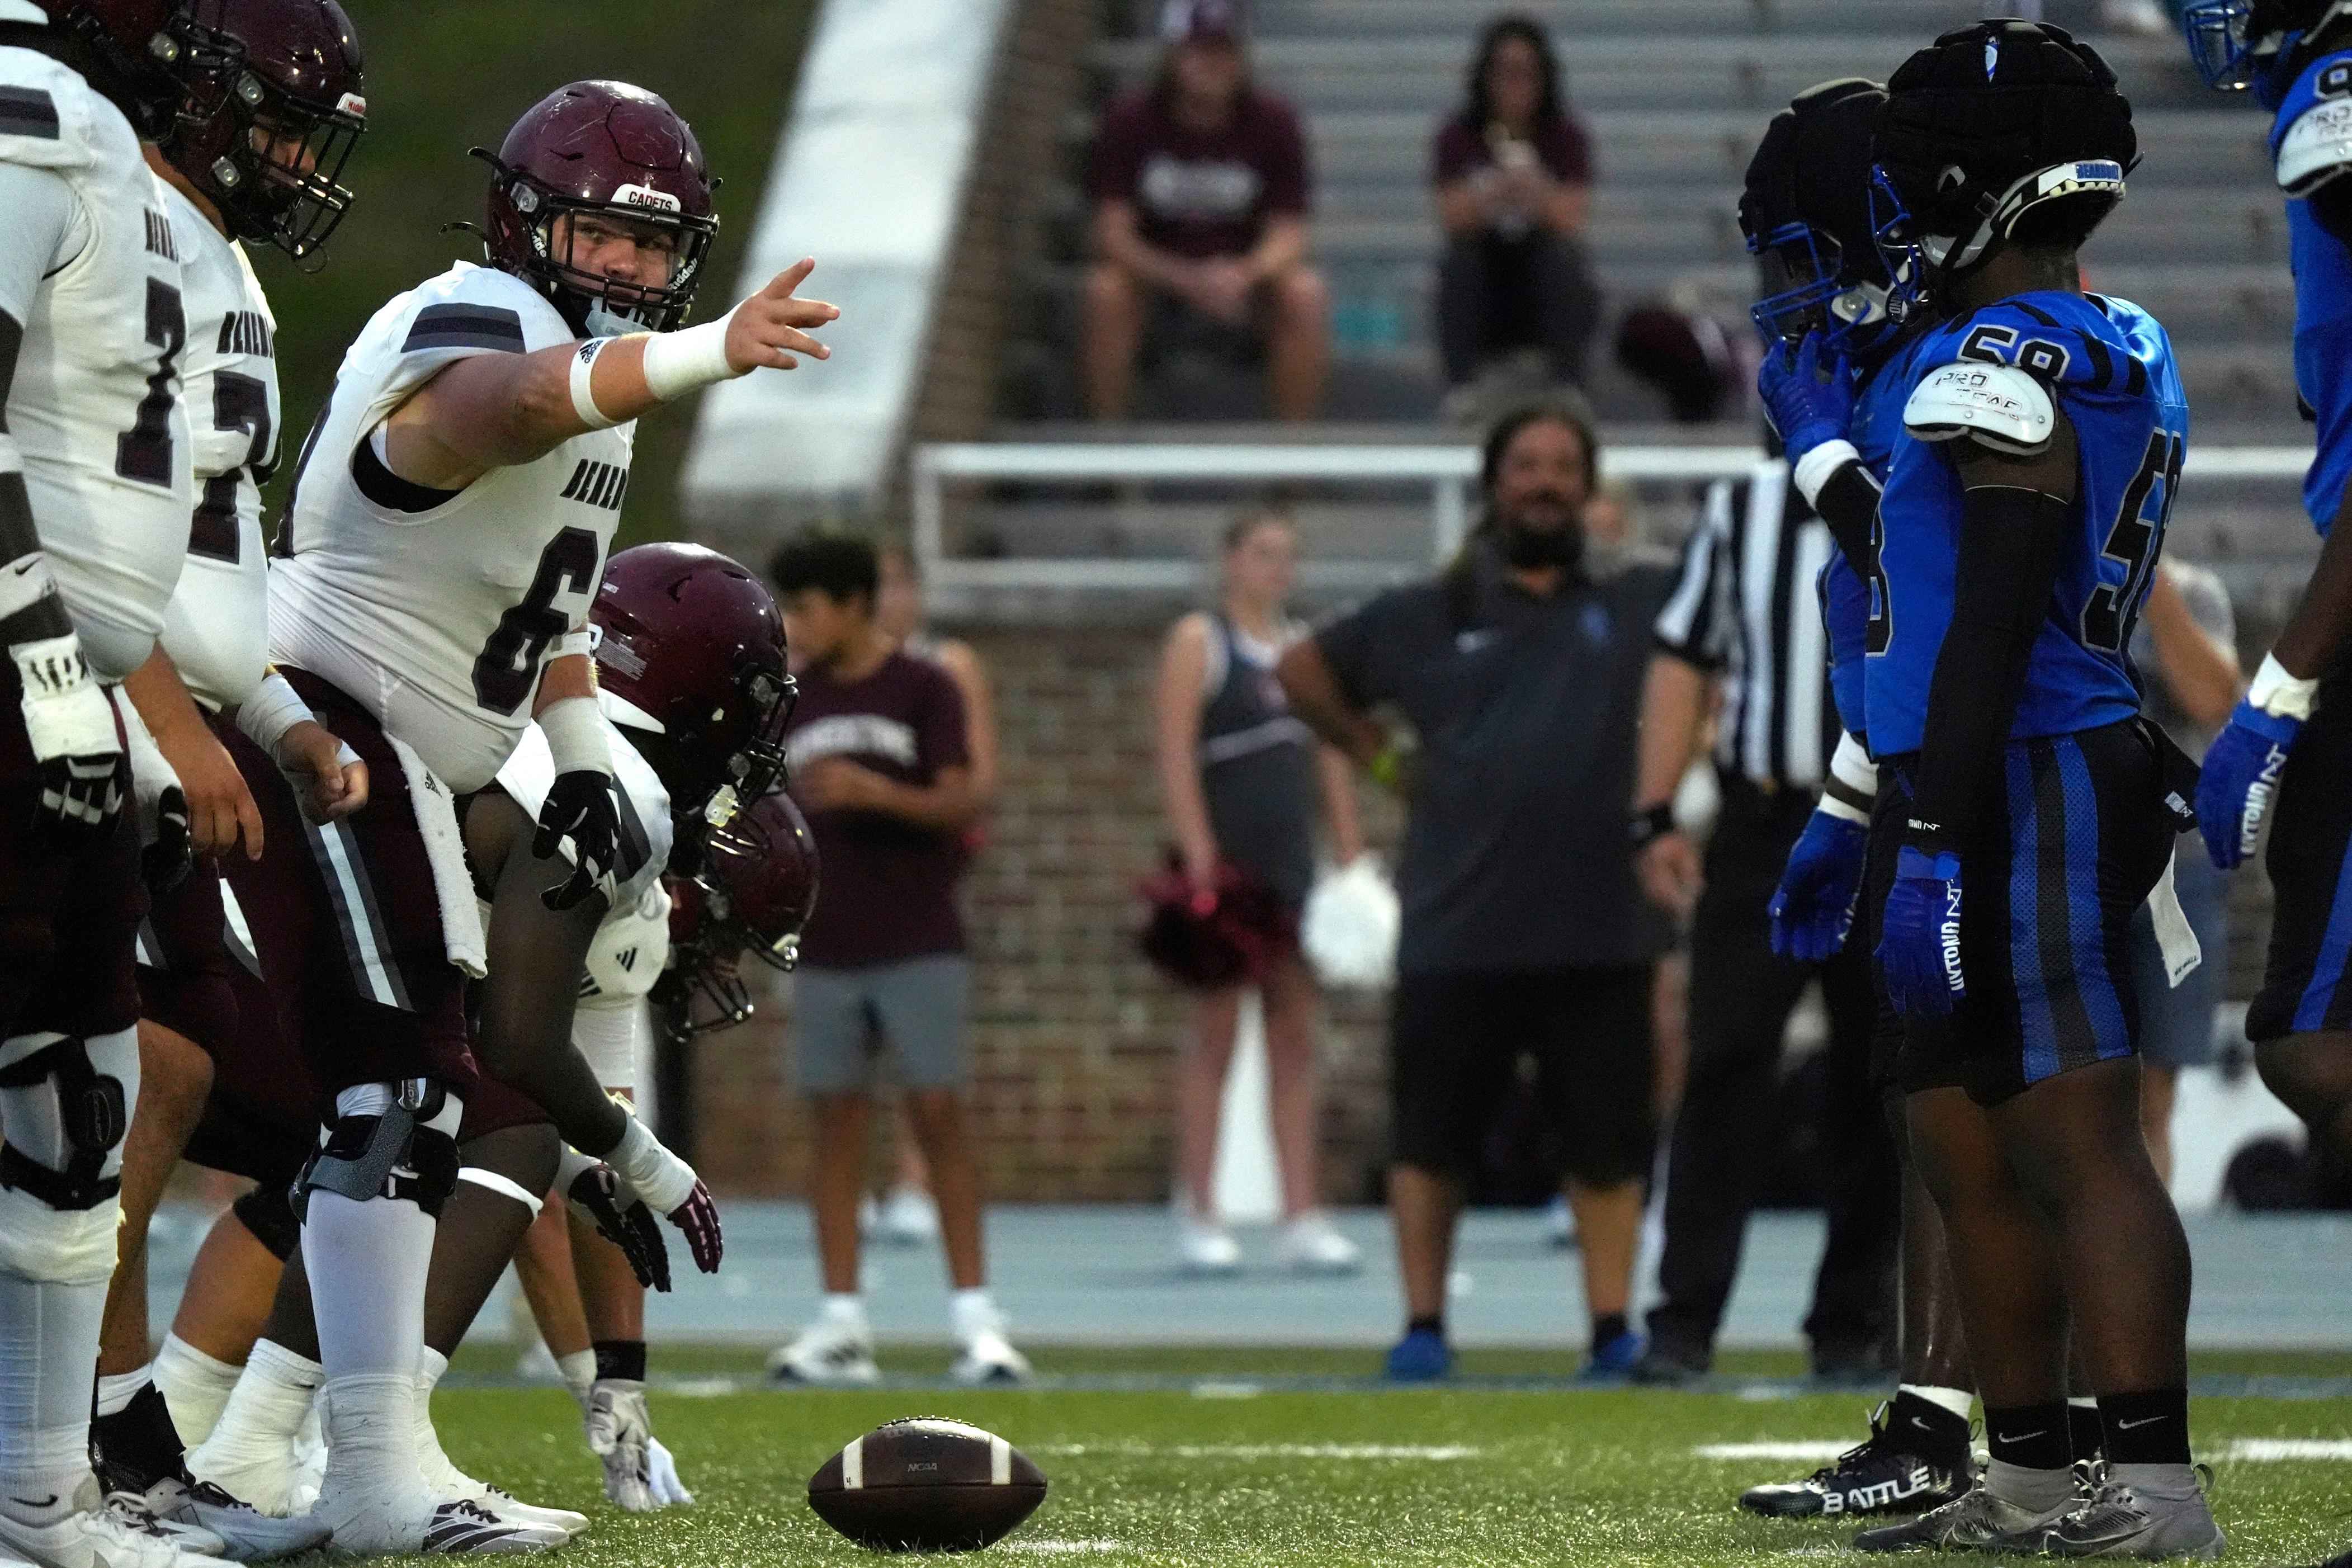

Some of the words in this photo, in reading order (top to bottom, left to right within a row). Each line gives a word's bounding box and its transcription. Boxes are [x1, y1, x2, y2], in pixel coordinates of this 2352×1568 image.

[629, 191, 672, 211] CADETS
[471, 526, 599, 718] 6
[1821, 1465, 1930, 1513] BATTLE
